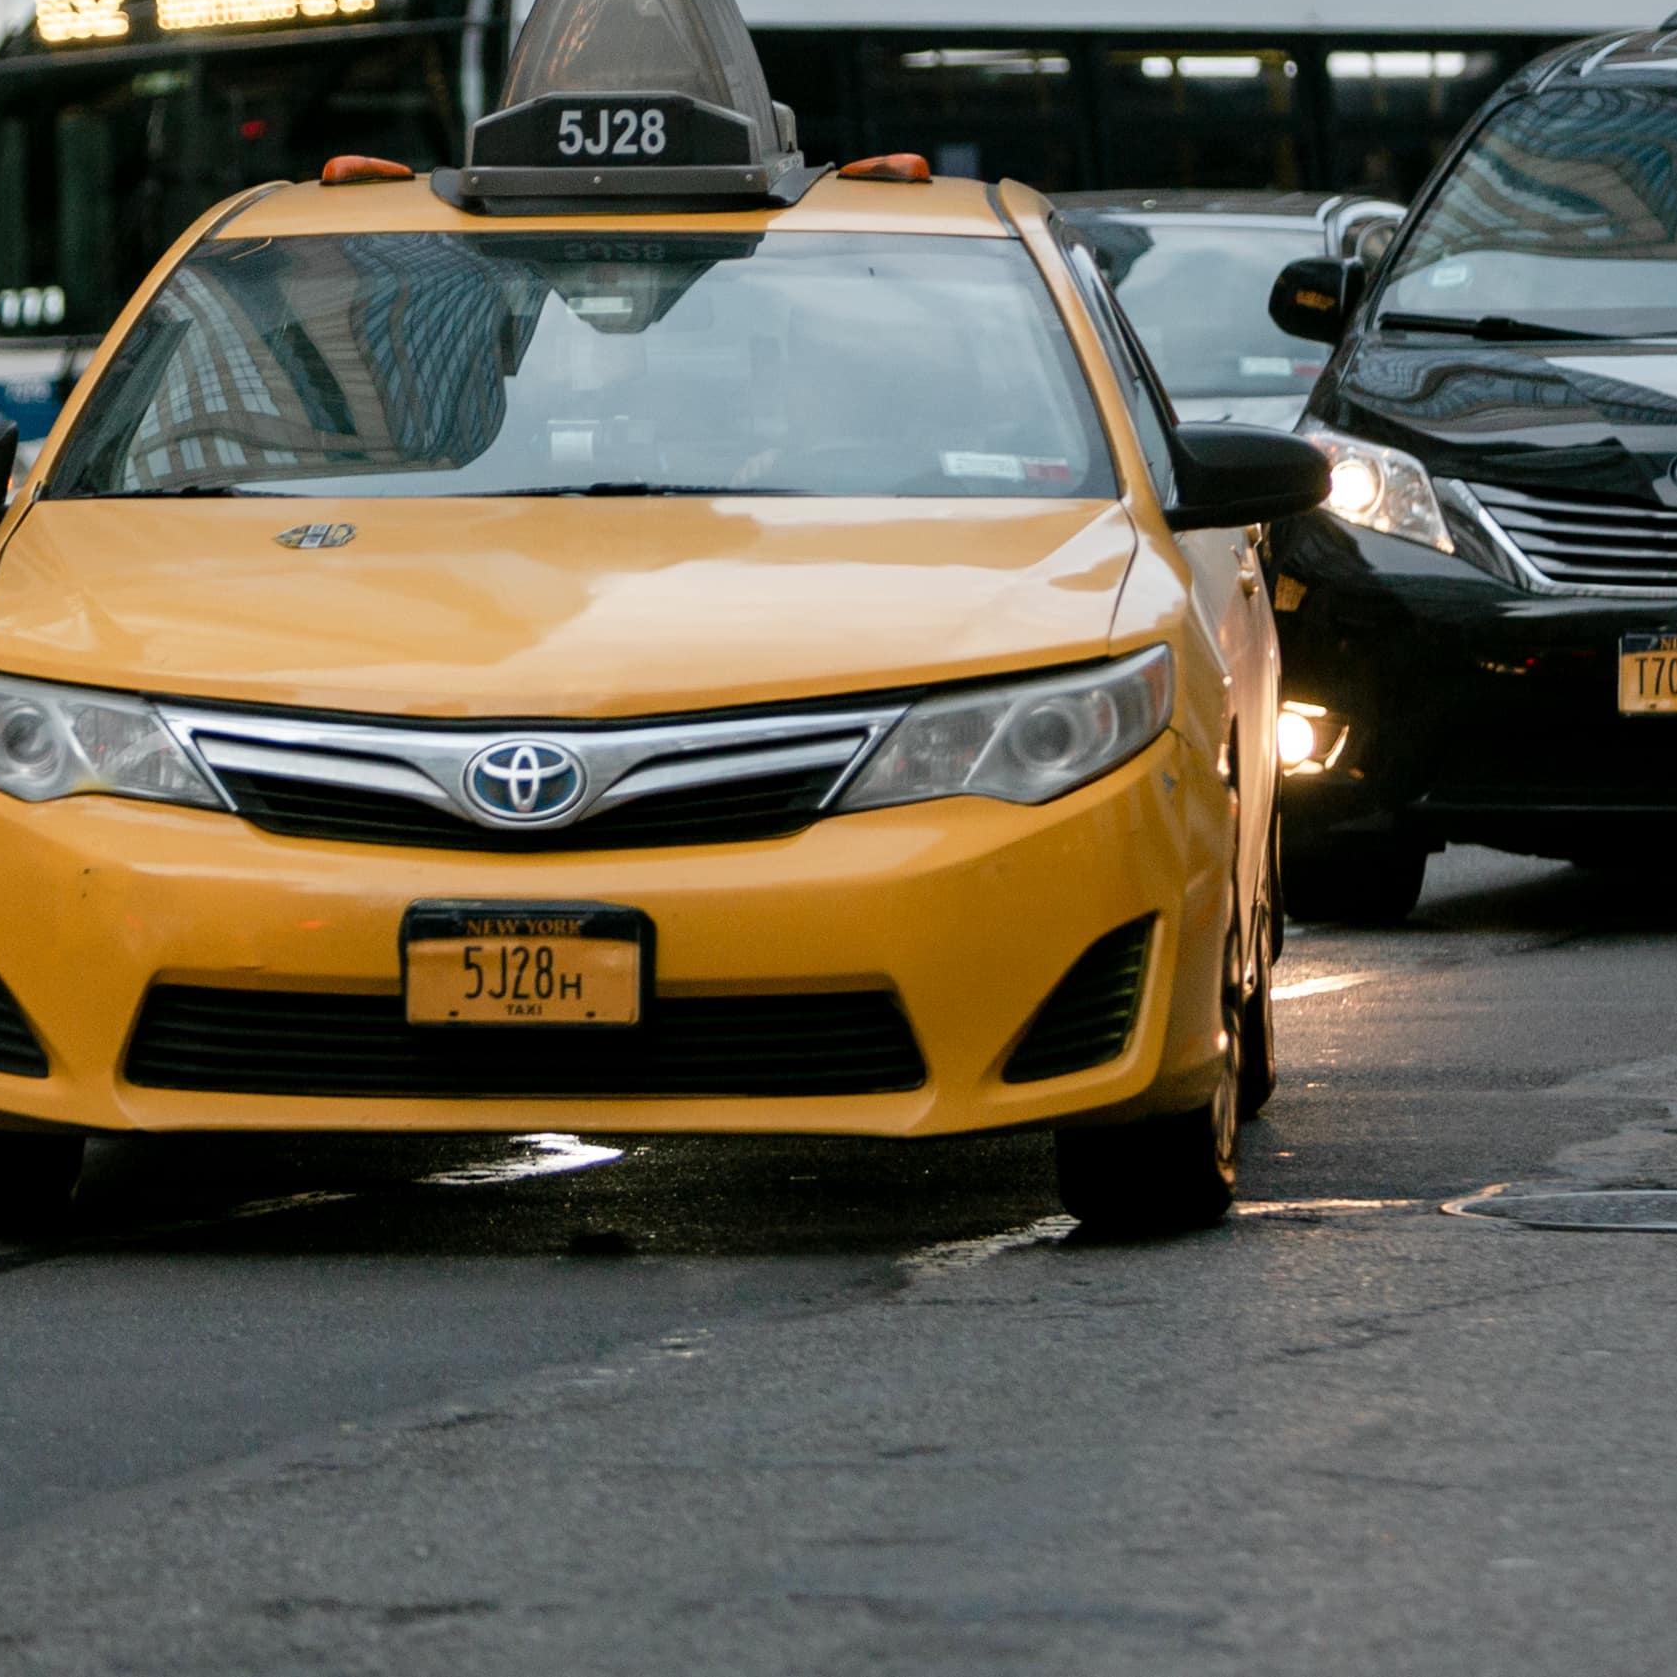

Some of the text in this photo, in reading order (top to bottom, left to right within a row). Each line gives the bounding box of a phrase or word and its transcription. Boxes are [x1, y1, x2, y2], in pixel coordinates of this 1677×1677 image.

[558, 109, 666, 155] 5J28
[466, 918, 581, 936] NEW YORK
[506, 1004, 543, 1016] TAXI
